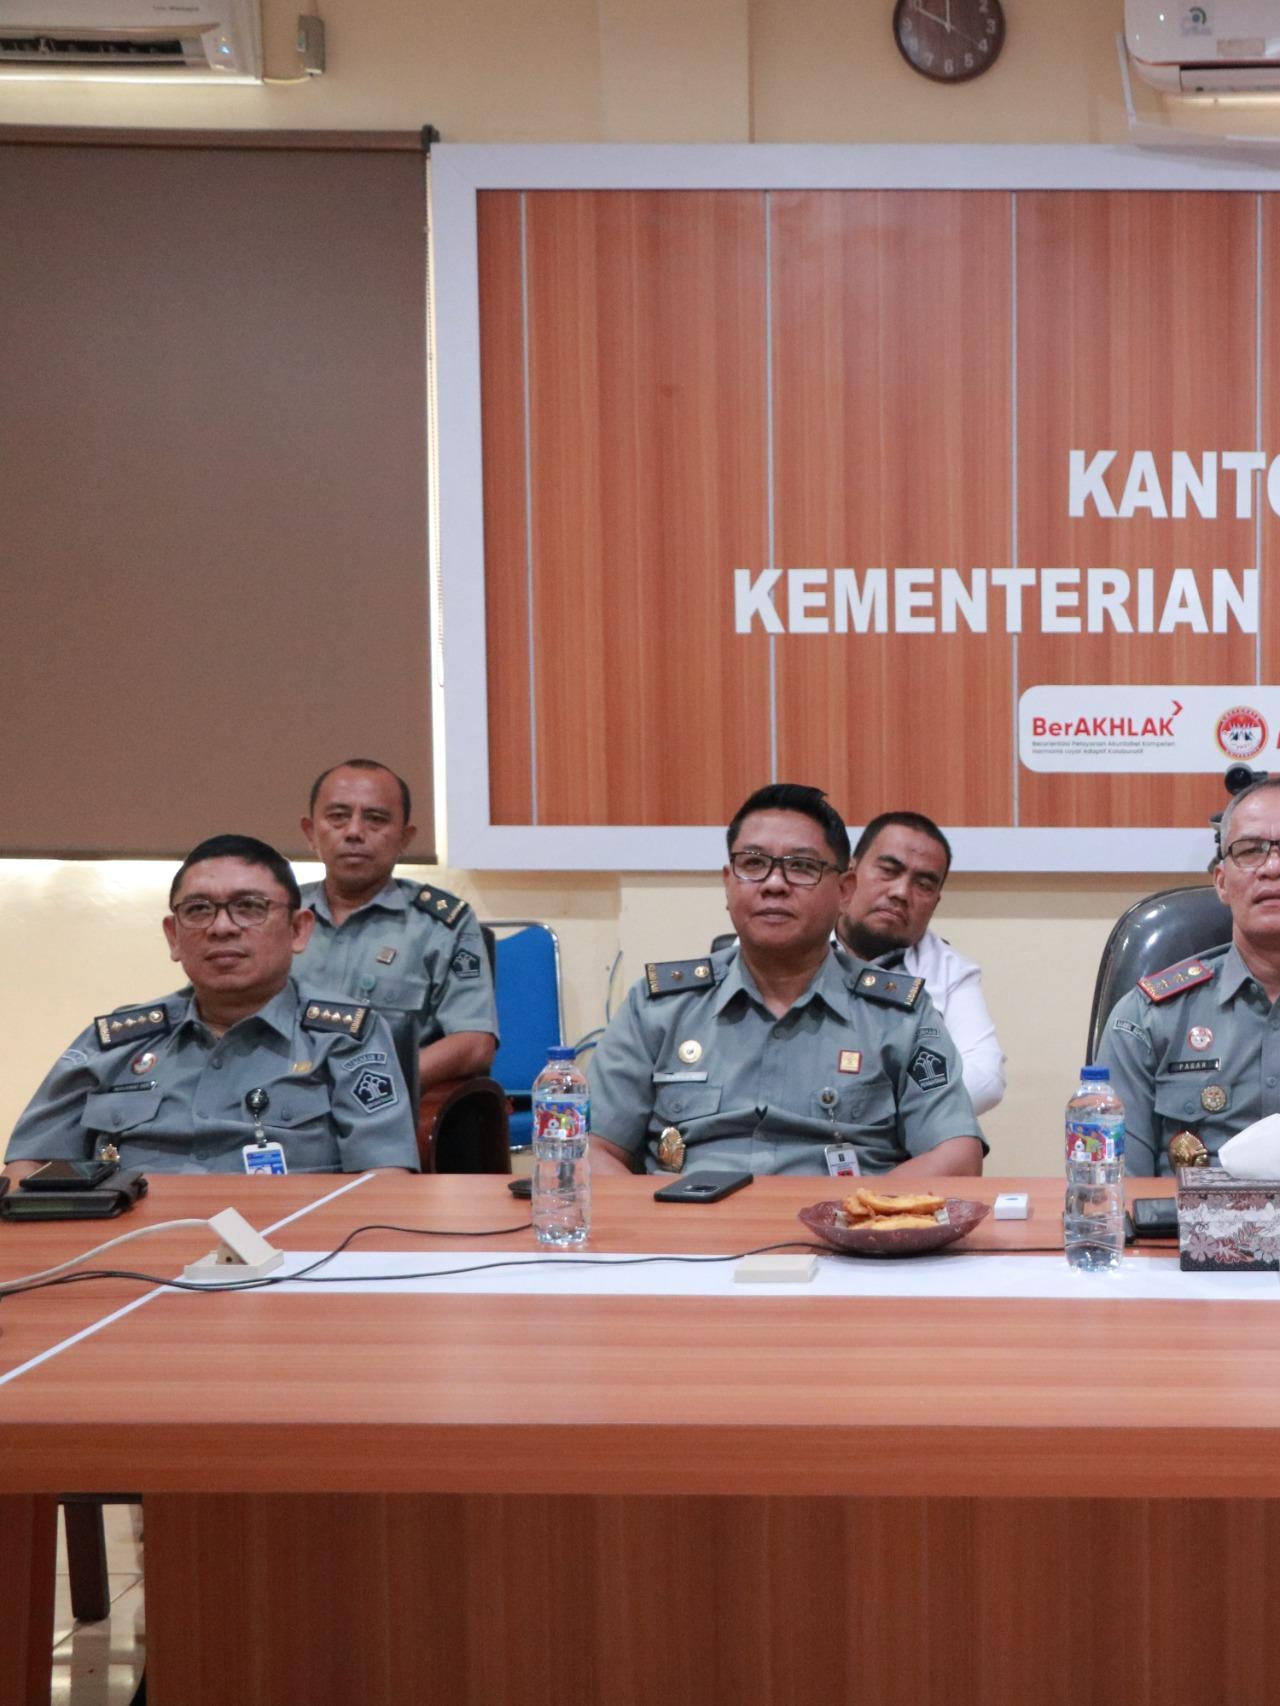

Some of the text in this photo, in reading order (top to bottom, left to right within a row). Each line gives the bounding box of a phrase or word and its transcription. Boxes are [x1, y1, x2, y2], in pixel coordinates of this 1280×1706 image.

[986, 19, 996, 34] 3
[979, 38, 988, 52] 4
[944, 58, 954, 74] 6
[733, 567, 1262, 635] KEMENTERIAN
[1032, 716, 1175, 737] BerAKHLAK
